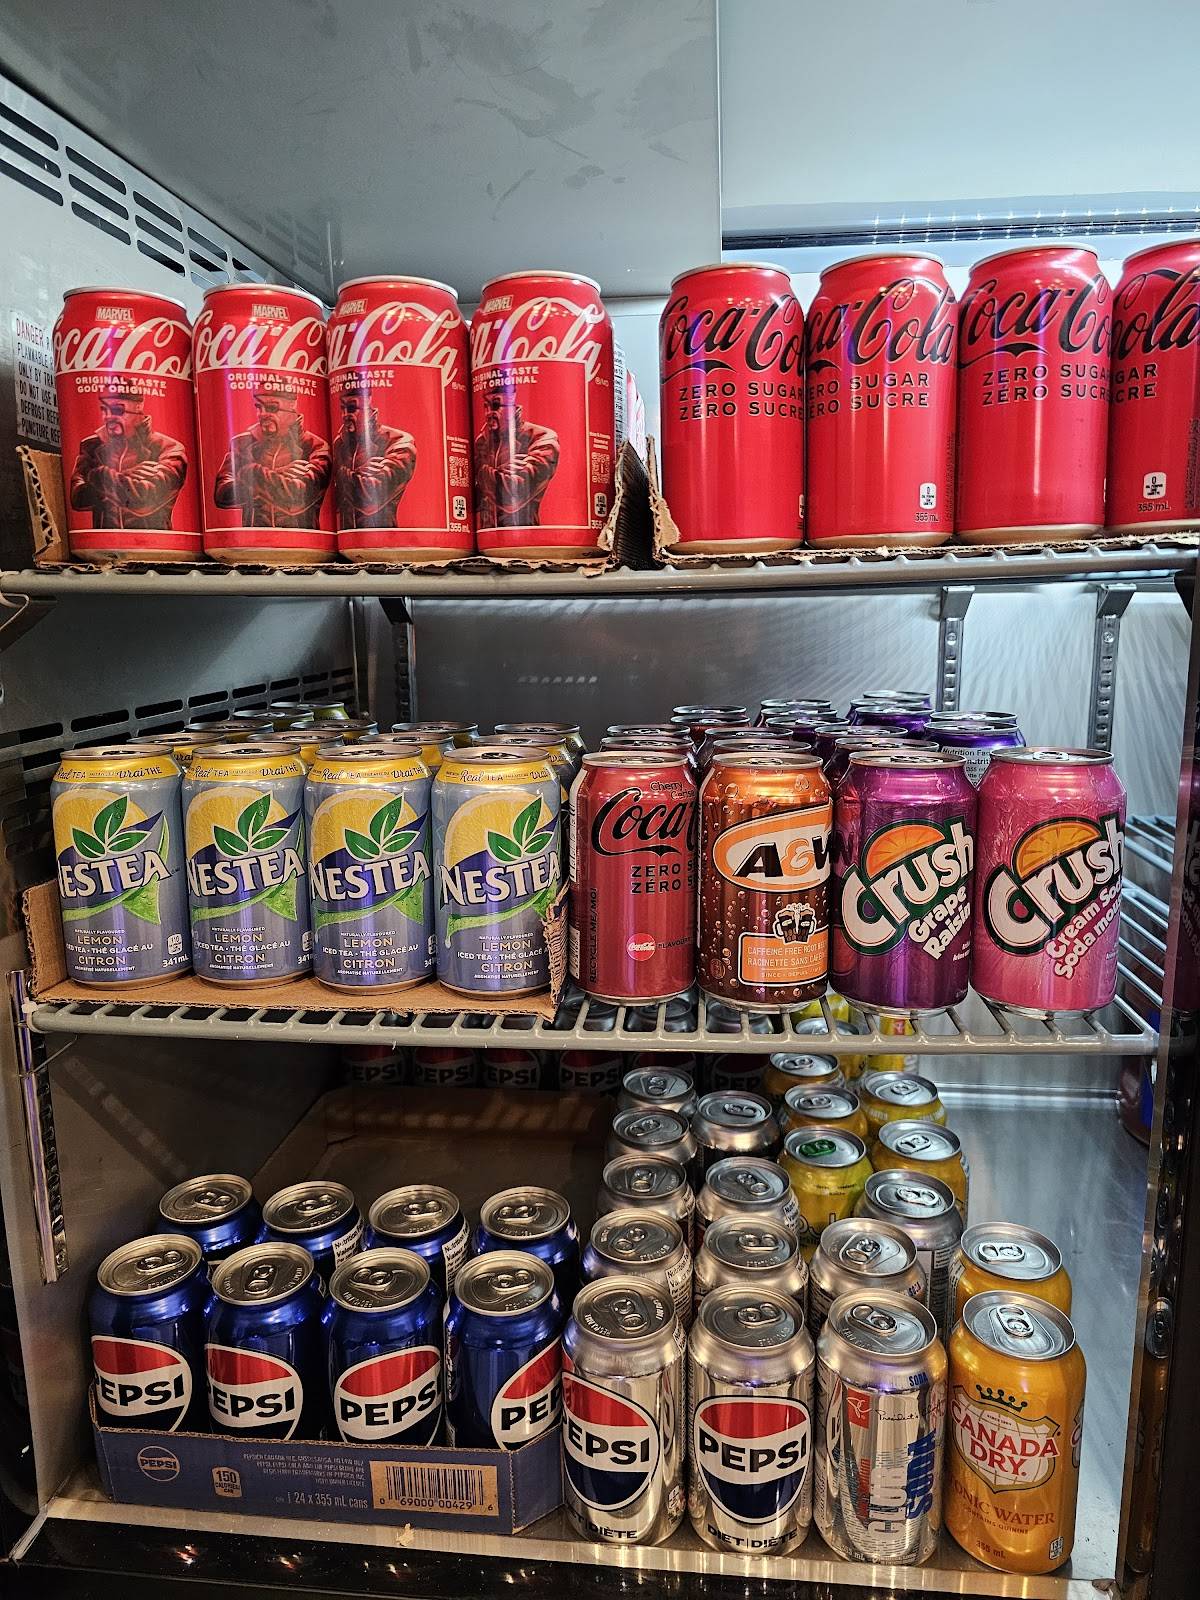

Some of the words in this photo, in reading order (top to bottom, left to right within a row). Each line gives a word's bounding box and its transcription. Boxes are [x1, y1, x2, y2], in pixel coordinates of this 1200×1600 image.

[98, 307, 133, 321] MARVEL
[254, 305, 288, 320] MARVEL
[361, 370, 394, 379] TASTE
[506, 366, 539, 375] TASTE
[982, 364, 1048, 386] ZERO
[1112, 363, 1158, 385] GAR
[75, 376, 127, 386] ORIGINAL
[131, 377, 167, 388] TASTE
[228, 373, 283, 383] ORIGINAL
[286, 376, 317, 388] TASTE
[230, 380, 260, 391] GOÛT
[264, 383, 316, 396] ORIGINAL
[345, 379, 393, 390] ORIGINAL
[489, 376, 537, 387] ORIGINAL
[809, 380, 840, 401] ERO
[850, 373, 928, 391] SUGAR
[20, 380, 27, 397] DO
[29, 384, 39, 401] NOT
[77, 383, 106, 394] GOÛT
[109, 385, 166, 397] ORIGINAL
[679, 382, 736, 402] ZERO
[982, 383, 1048, 407] ZÉRO
[1112, 382, 1157, 404] CRE
[850, 392, 928, 410] SUCRE
[20, 398, 45, 422] DEFROST
[679, 398, 736, 422] ZÉRO
[21, 417, 49, 442] PUNCTURE
[72, 771, 86, 779] TEA
[322, 768, 344, 781] Real
[460, 769, 484, 782] Real
[650, 781, 683, 793] Cherry
[187, 849, 305, 898] NESTEA
[309, 851, 433, 903] NESTEA
[631, 863, 681, 878] ZERO
[439, 852, 562, 908] NESTEA
[631, 879, 681, 894] ZÉRO
[842, 821, 974, 947] Crush
[988, 819, 1124, 947] Crush
[908, 885, 967, 943] Grape
[215, 934, 262, 943] LEMON
[923, 902, 971, 960] Raisin
[1047, 903, 1101, 959] Cream
[78, 936, 122, 945] LEMON
[230, 944, 247, 952] THÉ
[249, 942, 277, 951] GLACÉ
[344, 938, 393, 948] LEMON
[482, 940, 531, 951] LEMON
[110, 945, 138, 954] GLACÉ
[360, 949, 377, 957] THÉ
[379, 946, 407, 956] GLACÉ
[499, 952, 516, 960] THÉ
[518, 948, 542, 958] GLACÉ
[747, 946, 783, 956] CAFFEINE
[785, 946, 803, 955] FREE
[1055, 932, 1096, 979] Soda
[79, 956, 126, 966] CITRON
[215, 954, 265, 963] CITRON
[343, 958, 395, 968] CITRON
[747, 957, 789, 967] RACINETTE
[791, 957, 808, 966] SANS
[481, 961, 533, 972] CITRON
[909, 1372, 928, 1387] SODA
[94, 1372, 184, 1407] EPSI
[210, 1386, 295, 1418] EPSI
[501, 1384, 562, 1431] PEP
[951, 1400, 1059, 1457] CANADA
[563, 1417, 649, 1465] EPSI
[699, 1426, 806, 1474] PEPSI
[140, 1459, 177, 1468] PEPSI
[216, 1470, 237, 1484] 150
[295, 1491, 305, 1503] 24
[315, 1493, 332, 1506] 355
[349, 1498, 368, 1509] cans
[400, 1497, 434, 1507] 69000
[438, 1500, 473, 1510] 00429
[953, 1479, 990, 1514] ONIC
[993, 1506, 1055, 1526] WATER
[589, 1522, 638, 1539] DIÈTE
[707, 1525, 744, 1546] DIET
[751, 1529, 798, 1549] DIÈTE
